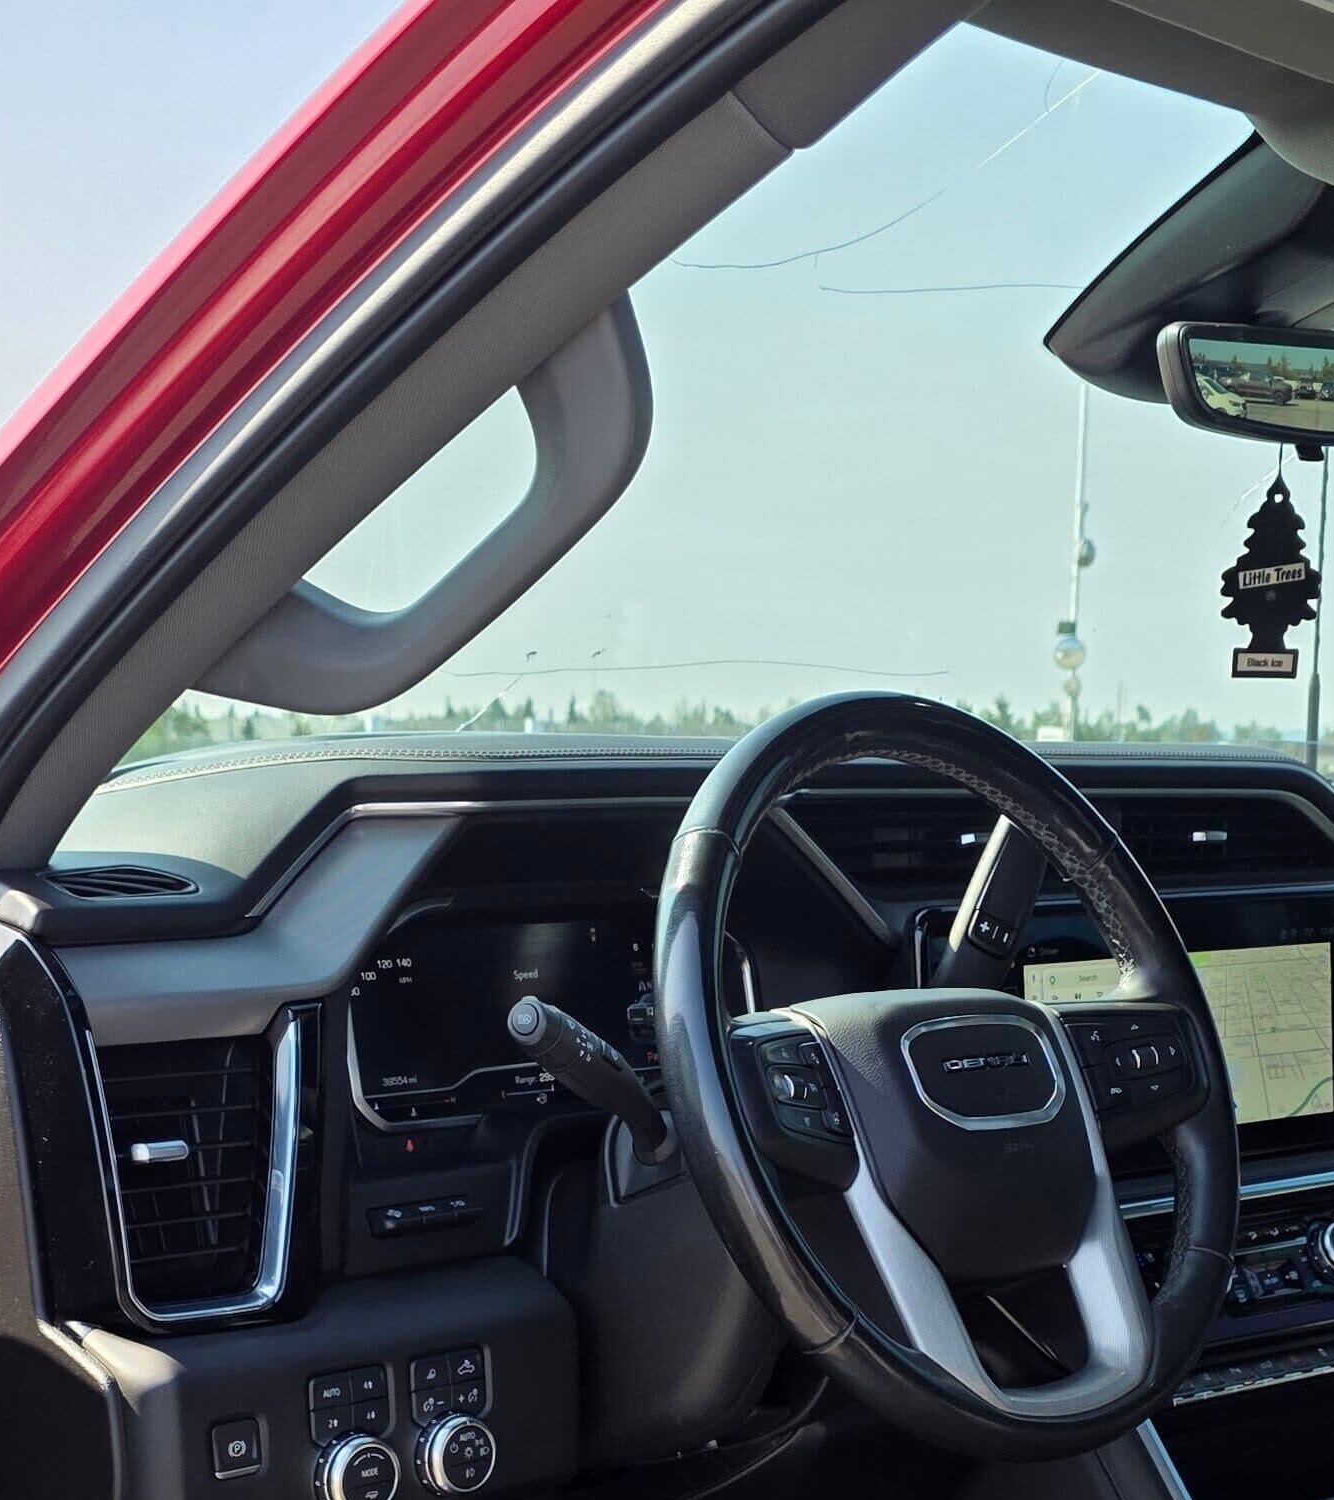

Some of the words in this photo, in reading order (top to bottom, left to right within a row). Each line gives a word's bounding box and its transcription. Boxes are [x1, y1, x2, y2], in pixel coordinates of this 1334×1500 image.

[1242, 569, 1271, 587] Little
[1274, 565, 1303, 582] Trees
[1247, 657, 1269, 667] Black
[1271, 658, 1283, 667] Ice
[377, 959, 393, 969] 120
[396, 958, 412, 967] 140
[360, 971, 377, 981] 100
[513, 969, 539, 981] Speed
[944, 1053, 1030, 1071] DENALI
[323, 1388, 340, 1398] AUTO
[459, 1432, 476, 1442] AUTO
[361, 1467, 379, 1478] MODE
